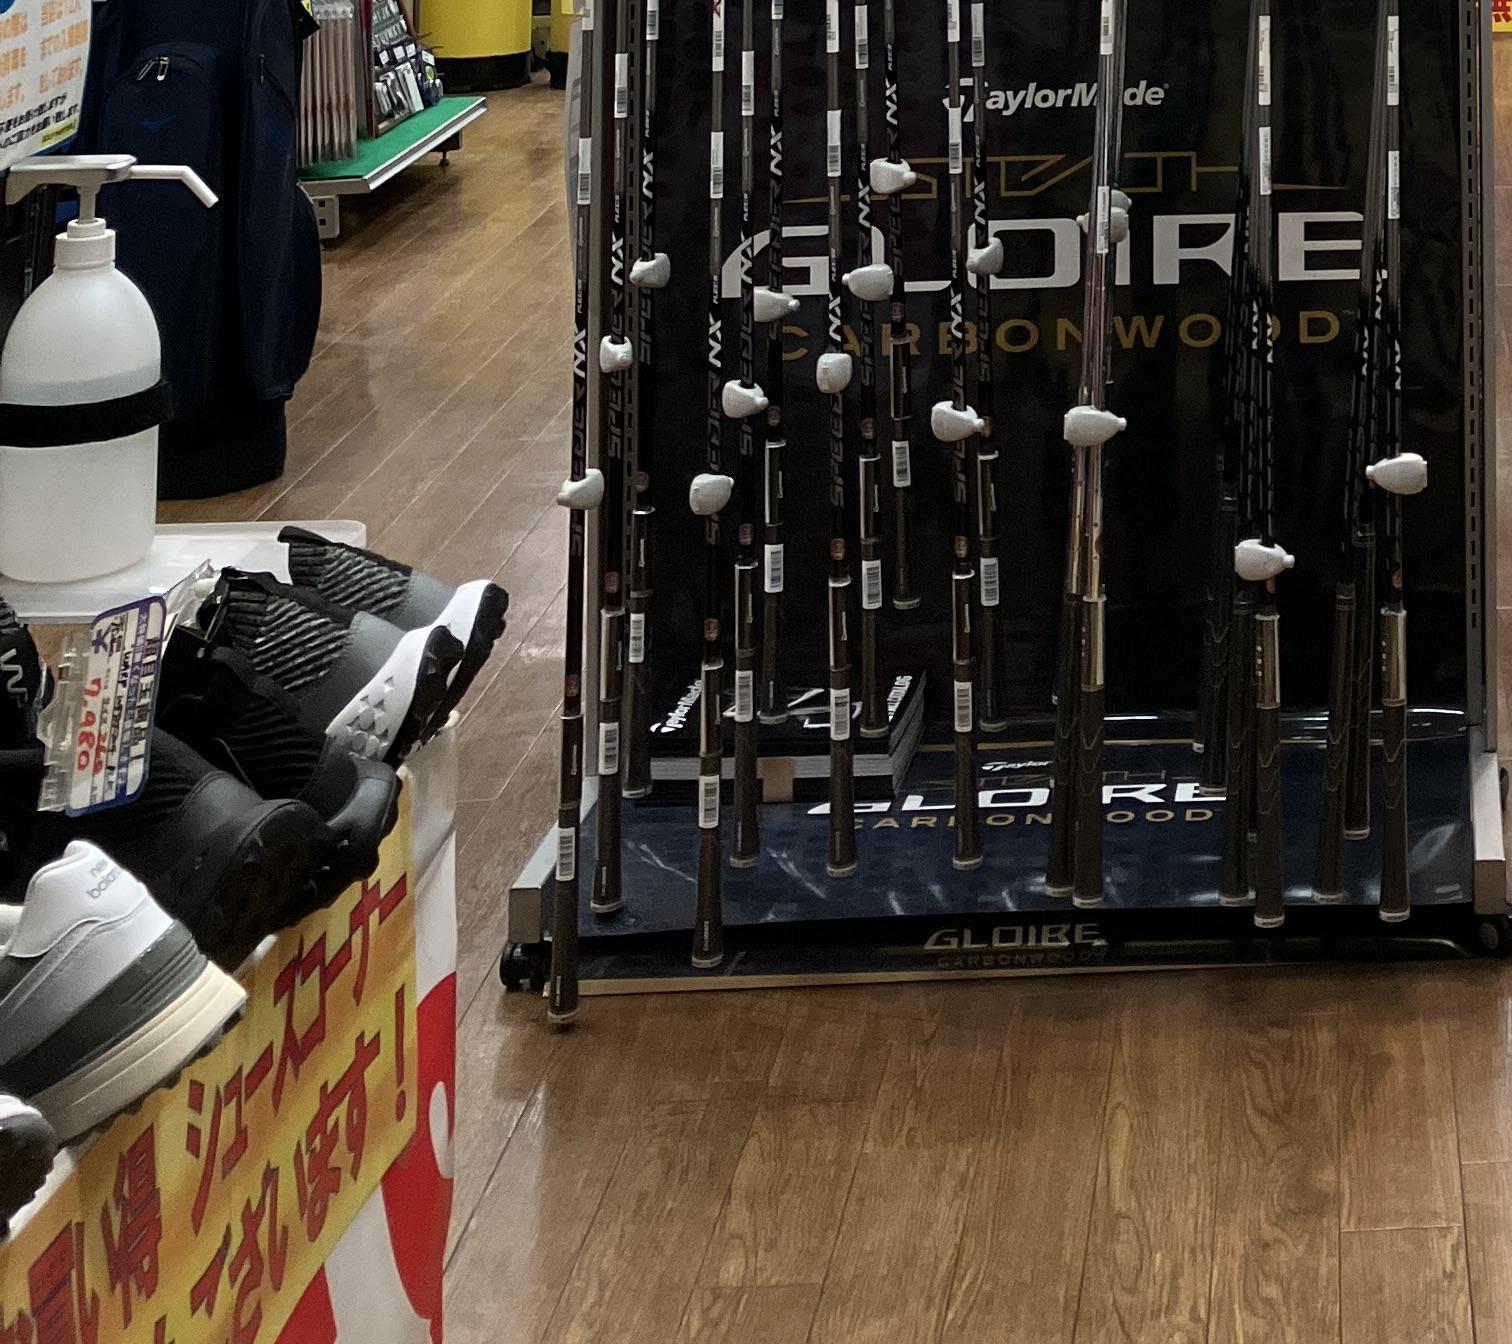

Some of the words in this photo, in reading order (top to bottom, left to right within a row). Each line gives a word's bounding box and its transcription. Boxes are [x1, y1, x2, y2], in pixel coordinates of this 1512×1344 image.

[943, 77, 1165, 122] TaylorMde
[721, 211, 1364, 300] GLOIRE
[807, 783, 1227, 815] GLORE
